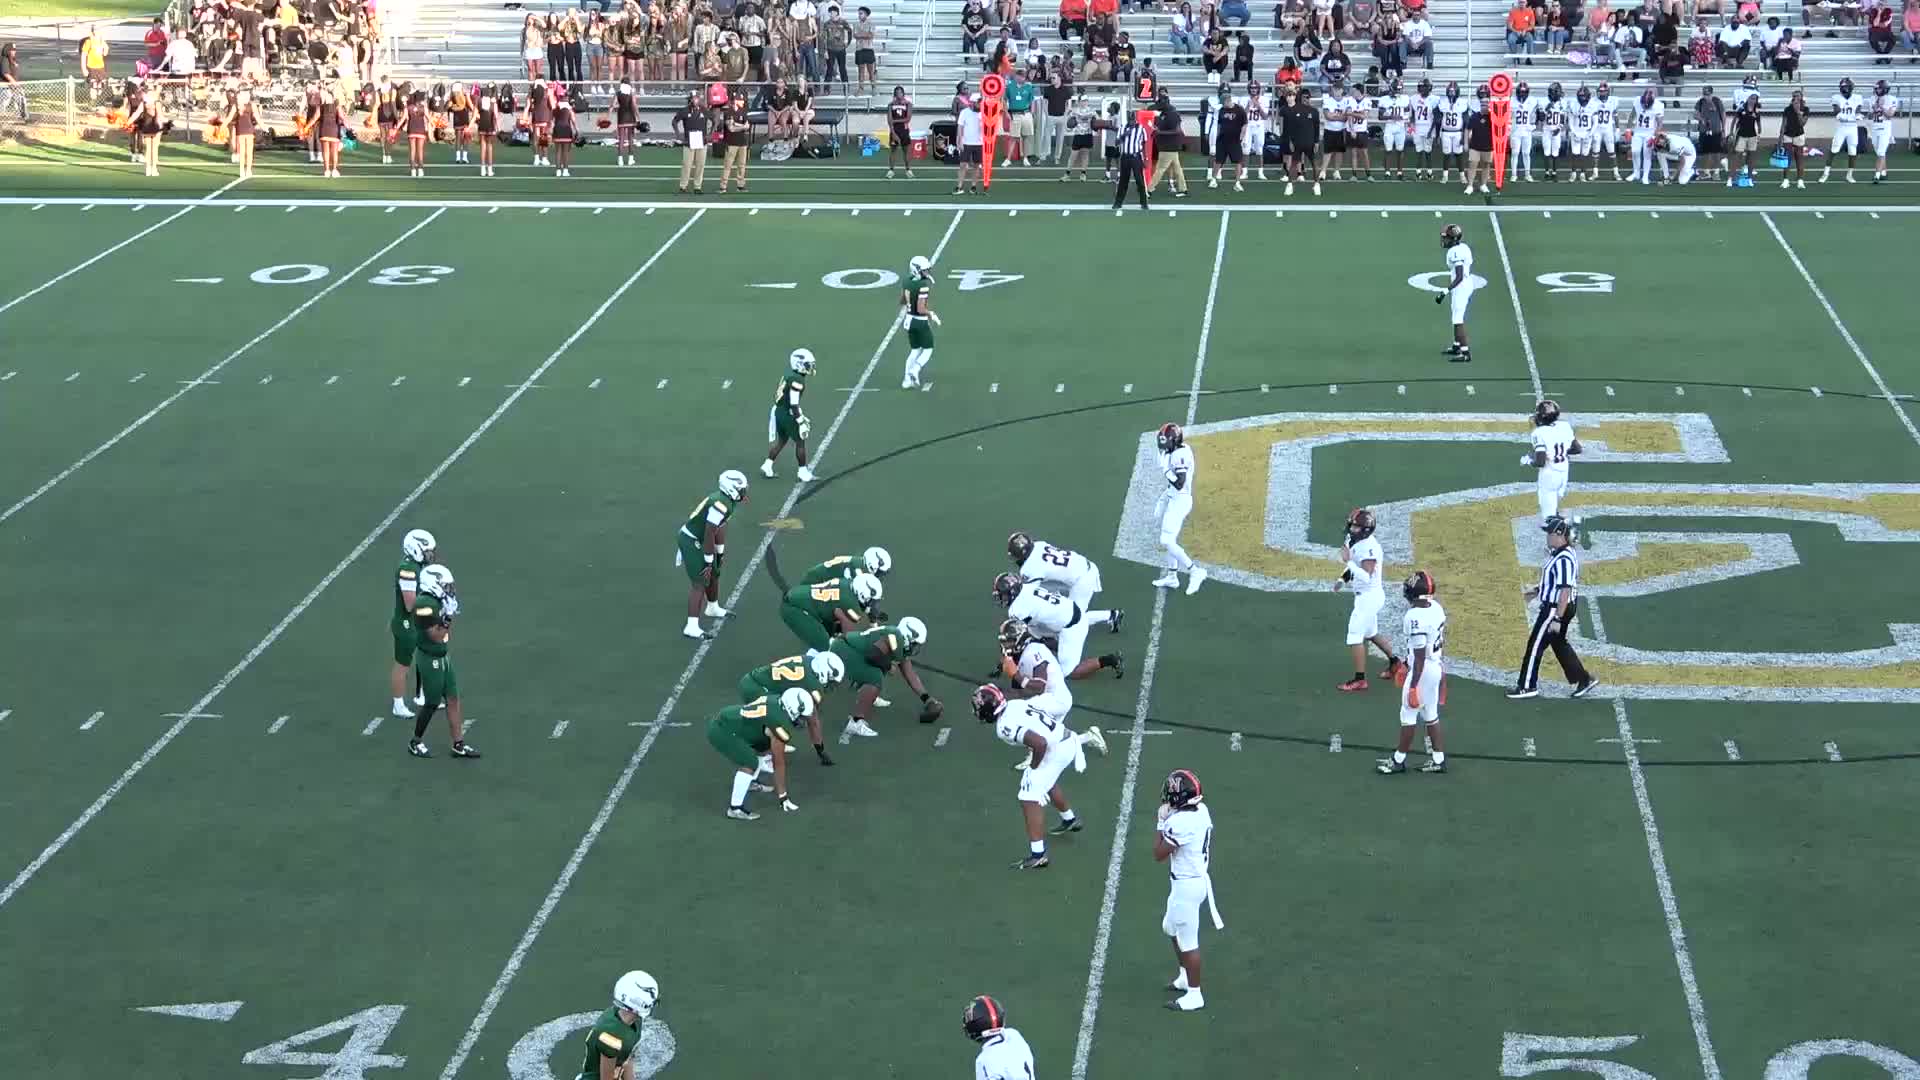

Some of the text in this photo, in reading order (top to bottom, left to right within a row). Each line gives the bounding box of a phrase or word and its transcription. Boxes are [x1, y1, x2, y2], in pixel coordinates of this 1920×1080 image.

[1139, 78, 1153, 97] 2
[1416, 106, 1428, 121] 74
[1445, 112, 1458, 127] 66
[1516, 110, 1528, 125] 26
[1578, 114, 1589, 128] 19
[914, 142, 922, 152] G
[250, 263, 455, 286] 30
[821, 268, 1025, 291] 40
[1407, 271, 1616, 293] 50
[1554, 441, 1566, 463] 11
[810, 577, 840, 602] 15
[770, 655, 805, 681] 12
